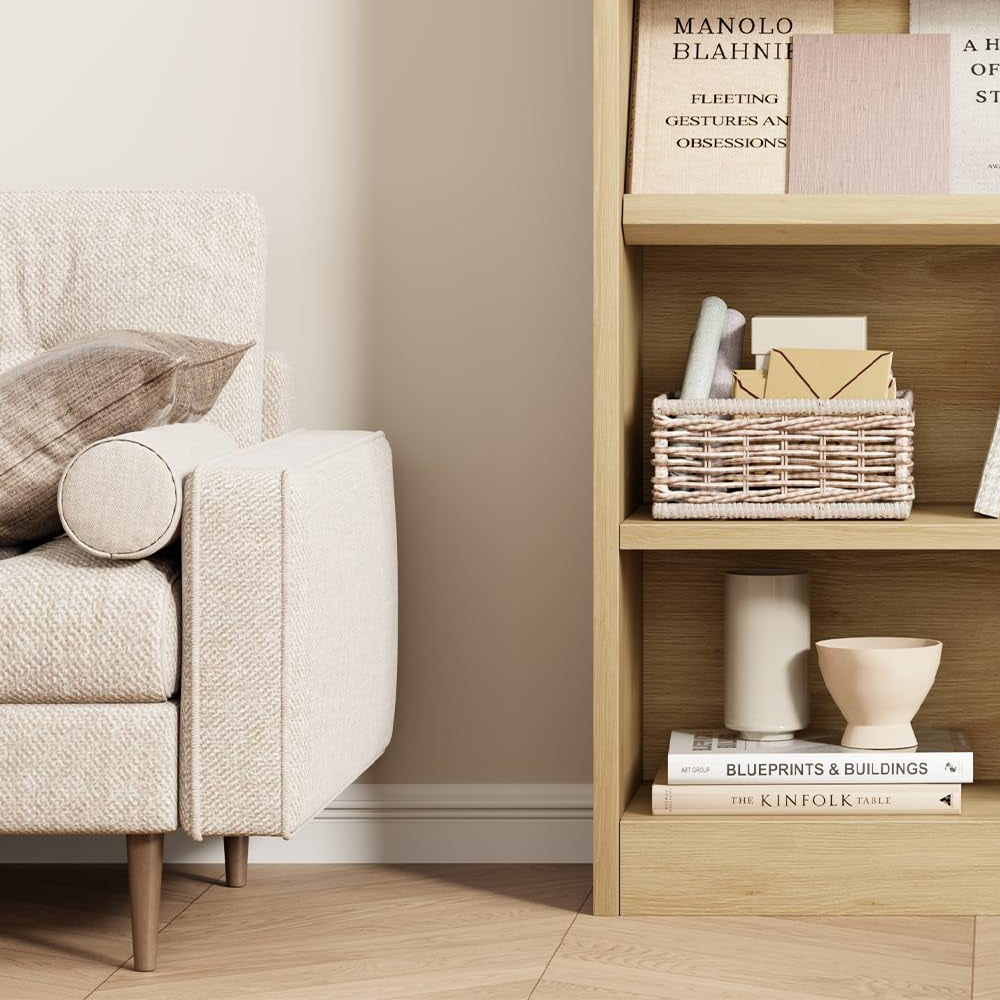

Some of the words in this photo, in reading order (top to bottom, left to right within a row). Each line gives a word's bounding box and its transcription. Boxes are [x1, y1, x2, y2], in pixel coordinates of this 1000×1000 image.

[672, 17, 793, 34] MANOLO
[963, 40, 978, 52] A
[971, 64, 1000, 76] OF
[692, 94, 777, 104] FLEETING
[666, 116, 758, 126] GESTURES
[763, 116, 791, 126] AN
[677, 138, 787, 148] OBSESSIONS
[727, 763, 824, 776] BLUEPRINTS
[829, 763, 839, 775] &
[845, 763, 928, 775] BUILDINGS
[762, 795, 852, 807] KINFOLK
